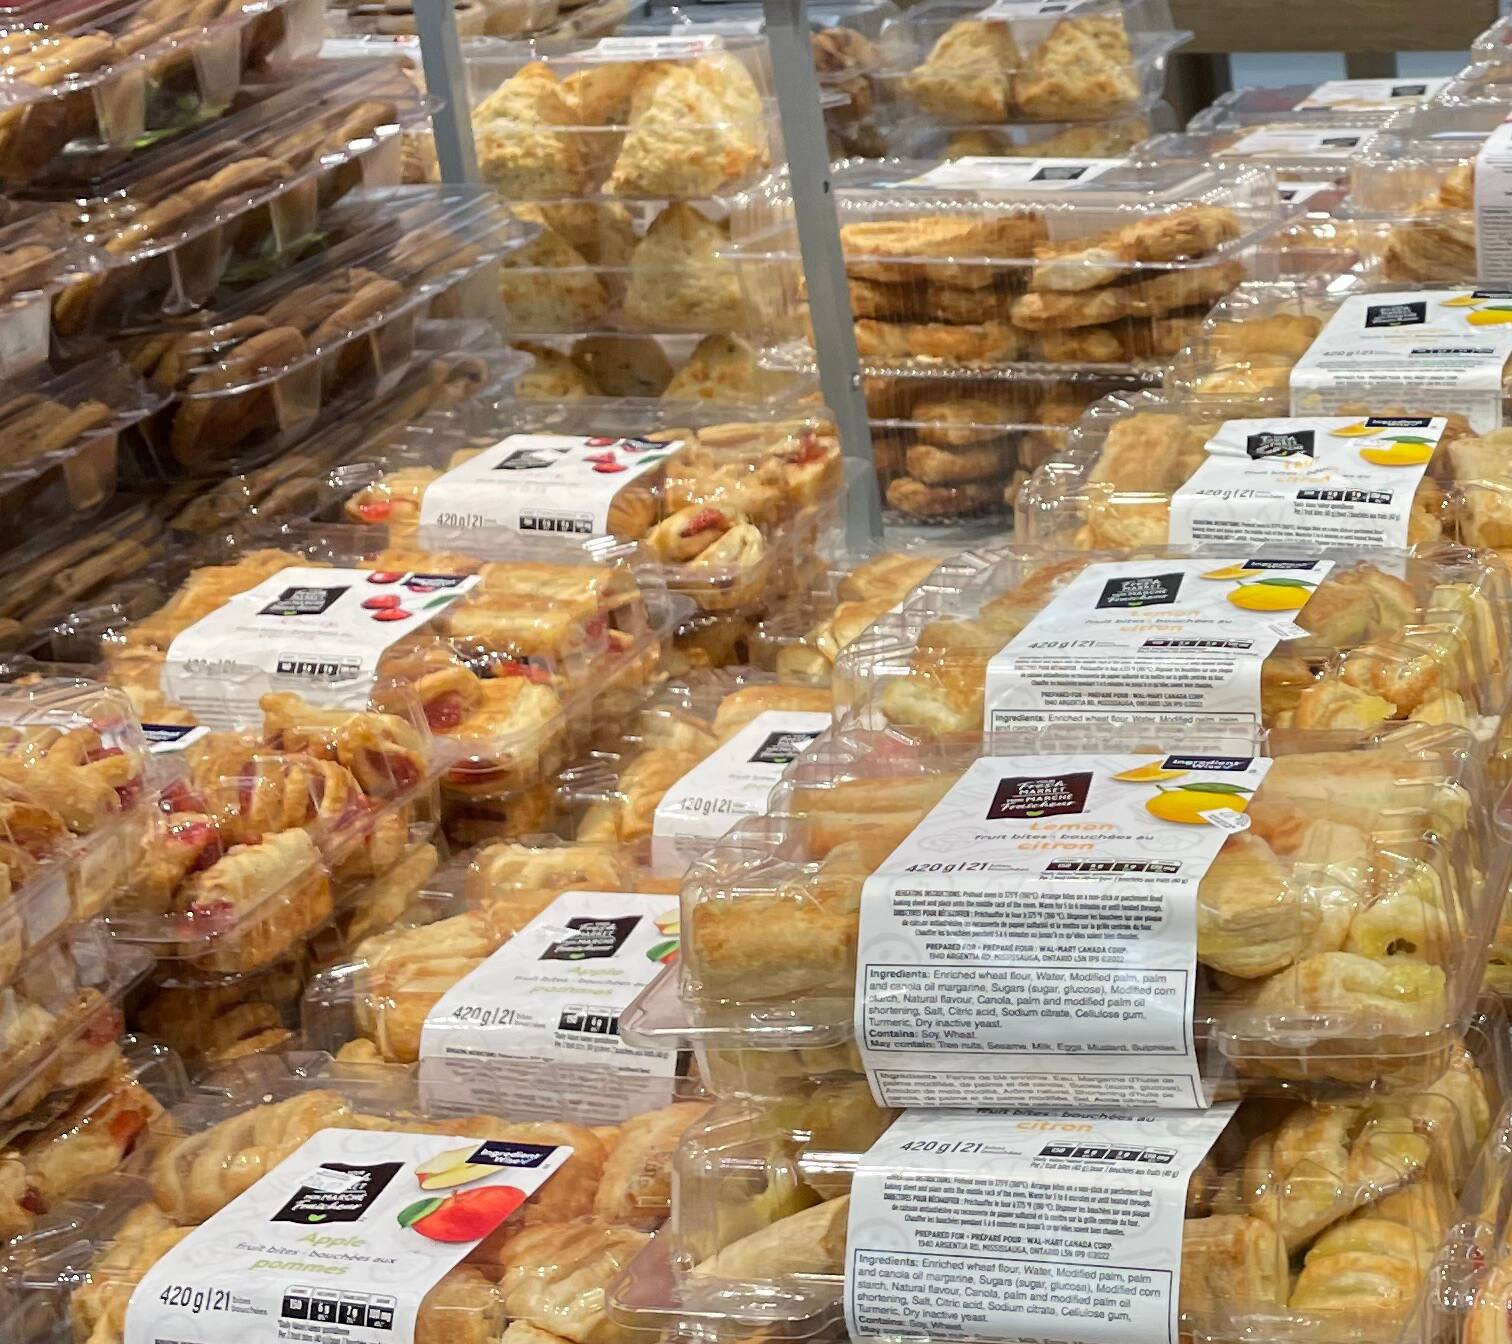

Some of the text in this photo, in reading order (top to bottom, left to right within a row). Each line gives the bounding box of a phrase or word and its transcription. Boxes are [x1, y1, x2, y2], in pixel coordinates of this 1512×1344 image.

[1029, 821, 1115, 831] Lemon
[1018, 841, 1095, 851] citron
[905, 863, 942, 872] 420
[1015, 1120, 1093, 1133] citron
[900, 1141, 938, 1151] 420
[300, 1232, 367, 1248] Apple
[251, 1258, 349, 1275] pommes
[160, 1285, 190, 1306] 420
